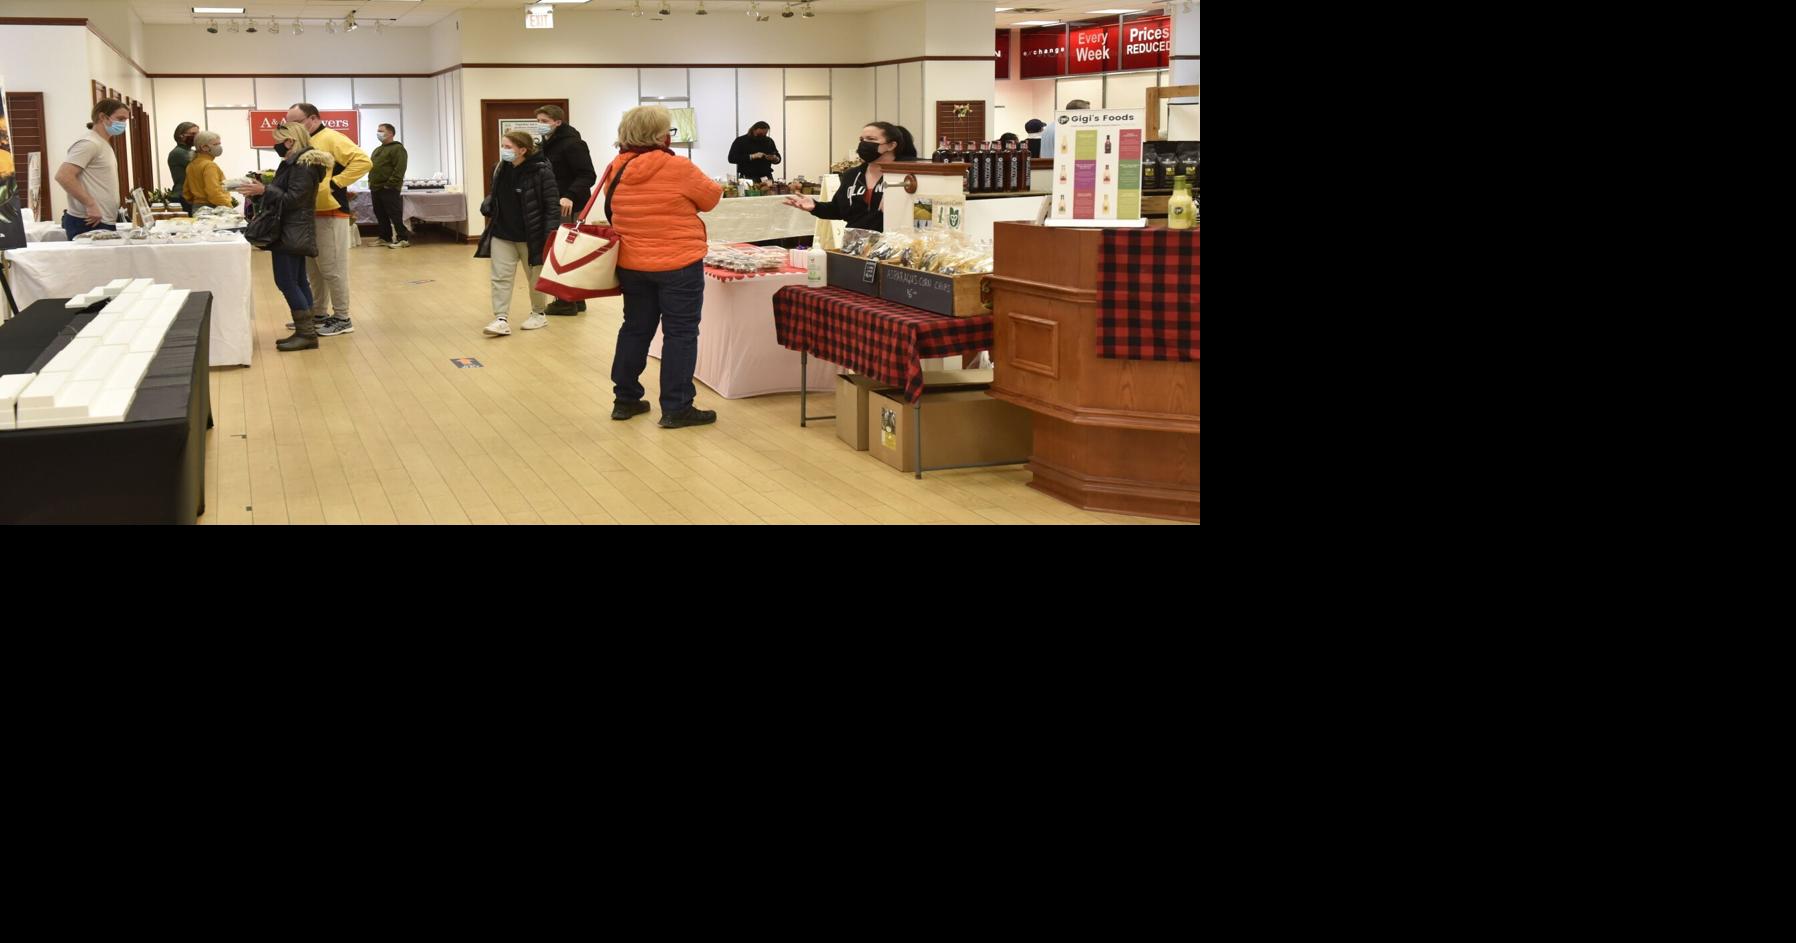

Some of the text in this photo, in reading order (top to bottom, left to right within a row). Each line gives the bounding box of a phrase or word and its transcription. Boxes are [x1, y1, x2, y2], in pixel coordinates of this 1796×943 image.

[530, 14, 549, 27] EXIT
[1078, 31, 1108, 46] Every
[1130, 27, 1170, 42] Prices
[1076, 45, 1110, 62] Week
[1126, 40, 1170, 55] REDUCED
[1071, 115, 1100, 124] Gigi's
[1103, 114, 1135, 122] Foods
